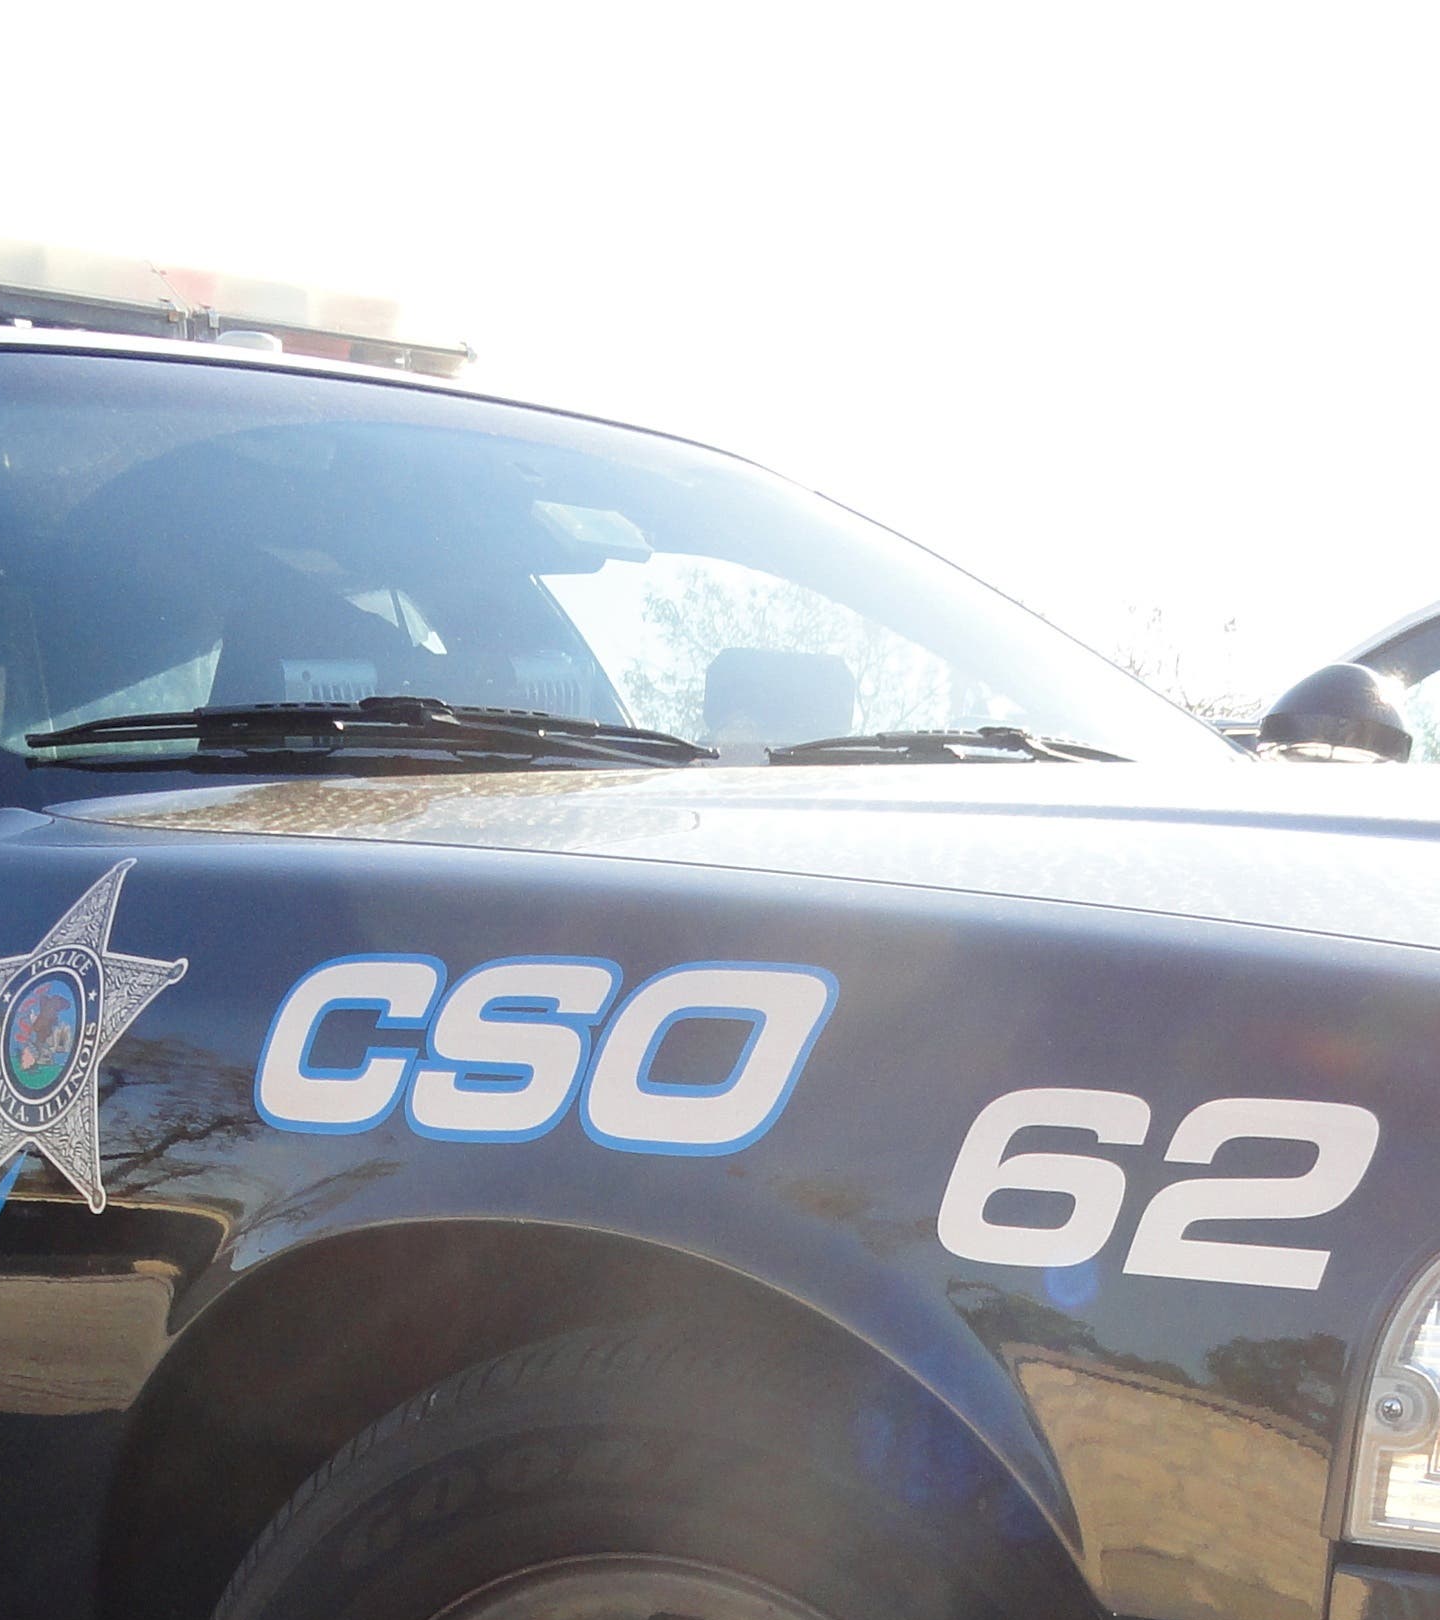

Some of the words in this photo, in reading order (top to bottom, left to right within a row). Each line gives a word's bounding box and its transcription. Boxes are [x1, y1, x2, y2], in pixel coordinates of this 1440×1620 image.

[30, 951, 94, 977] POLICE
[37, 1021, 97, 1123] ILLINOIS
[254, 952, 838, 1157] CSO
[937, 1088, 1380, 1291] 62
